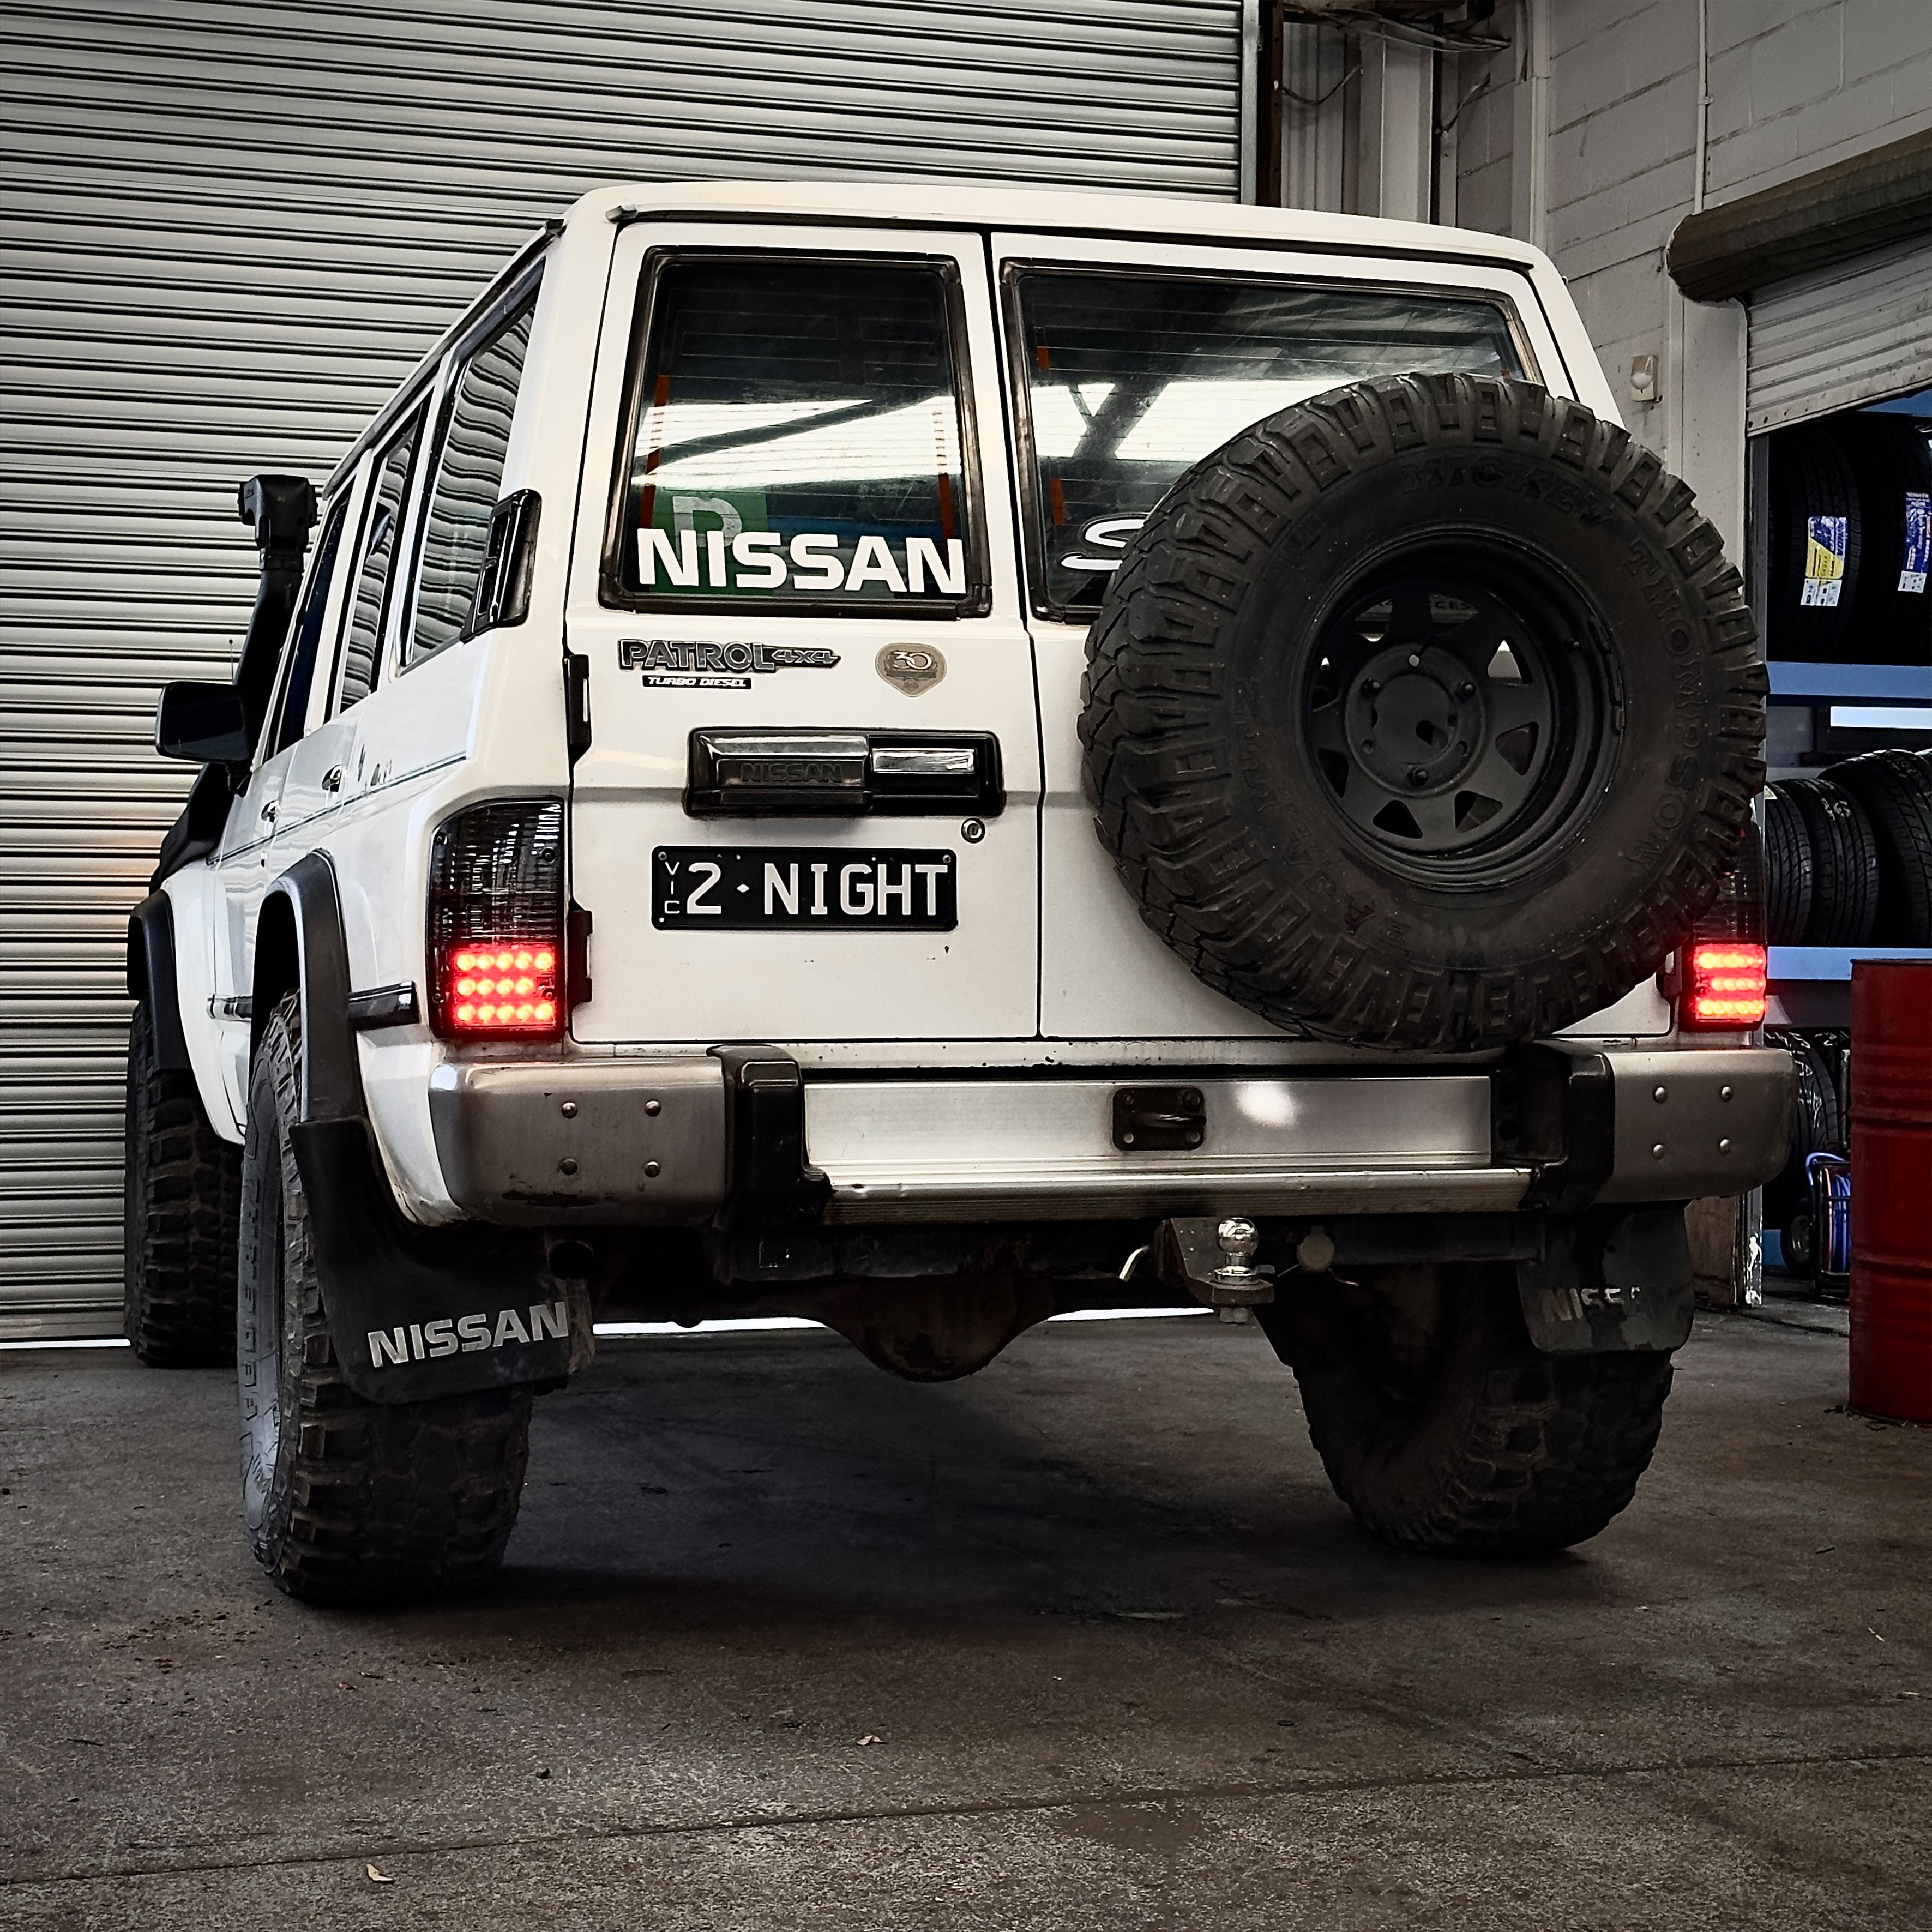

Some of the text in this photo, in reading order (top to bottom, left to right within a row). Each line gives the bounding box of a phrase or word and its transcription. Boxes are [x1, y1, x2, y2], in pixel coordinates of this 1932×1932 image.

[1402, 455, 1615, 527] MICKEY
[637, 528, 966, 594] NISSAN
[618, 639, 776, 673] PATROL
[648, 676, 747, 687] TURBO DIESEL
[893, 651, 932, 670] 30
[1622, 537, 1708, 872] THOMPSON
[741, 762, 844, 784] NISSAN
[664, 861, 681, 914] VIC
[368, 1301, 569, 1368] NISSAN
